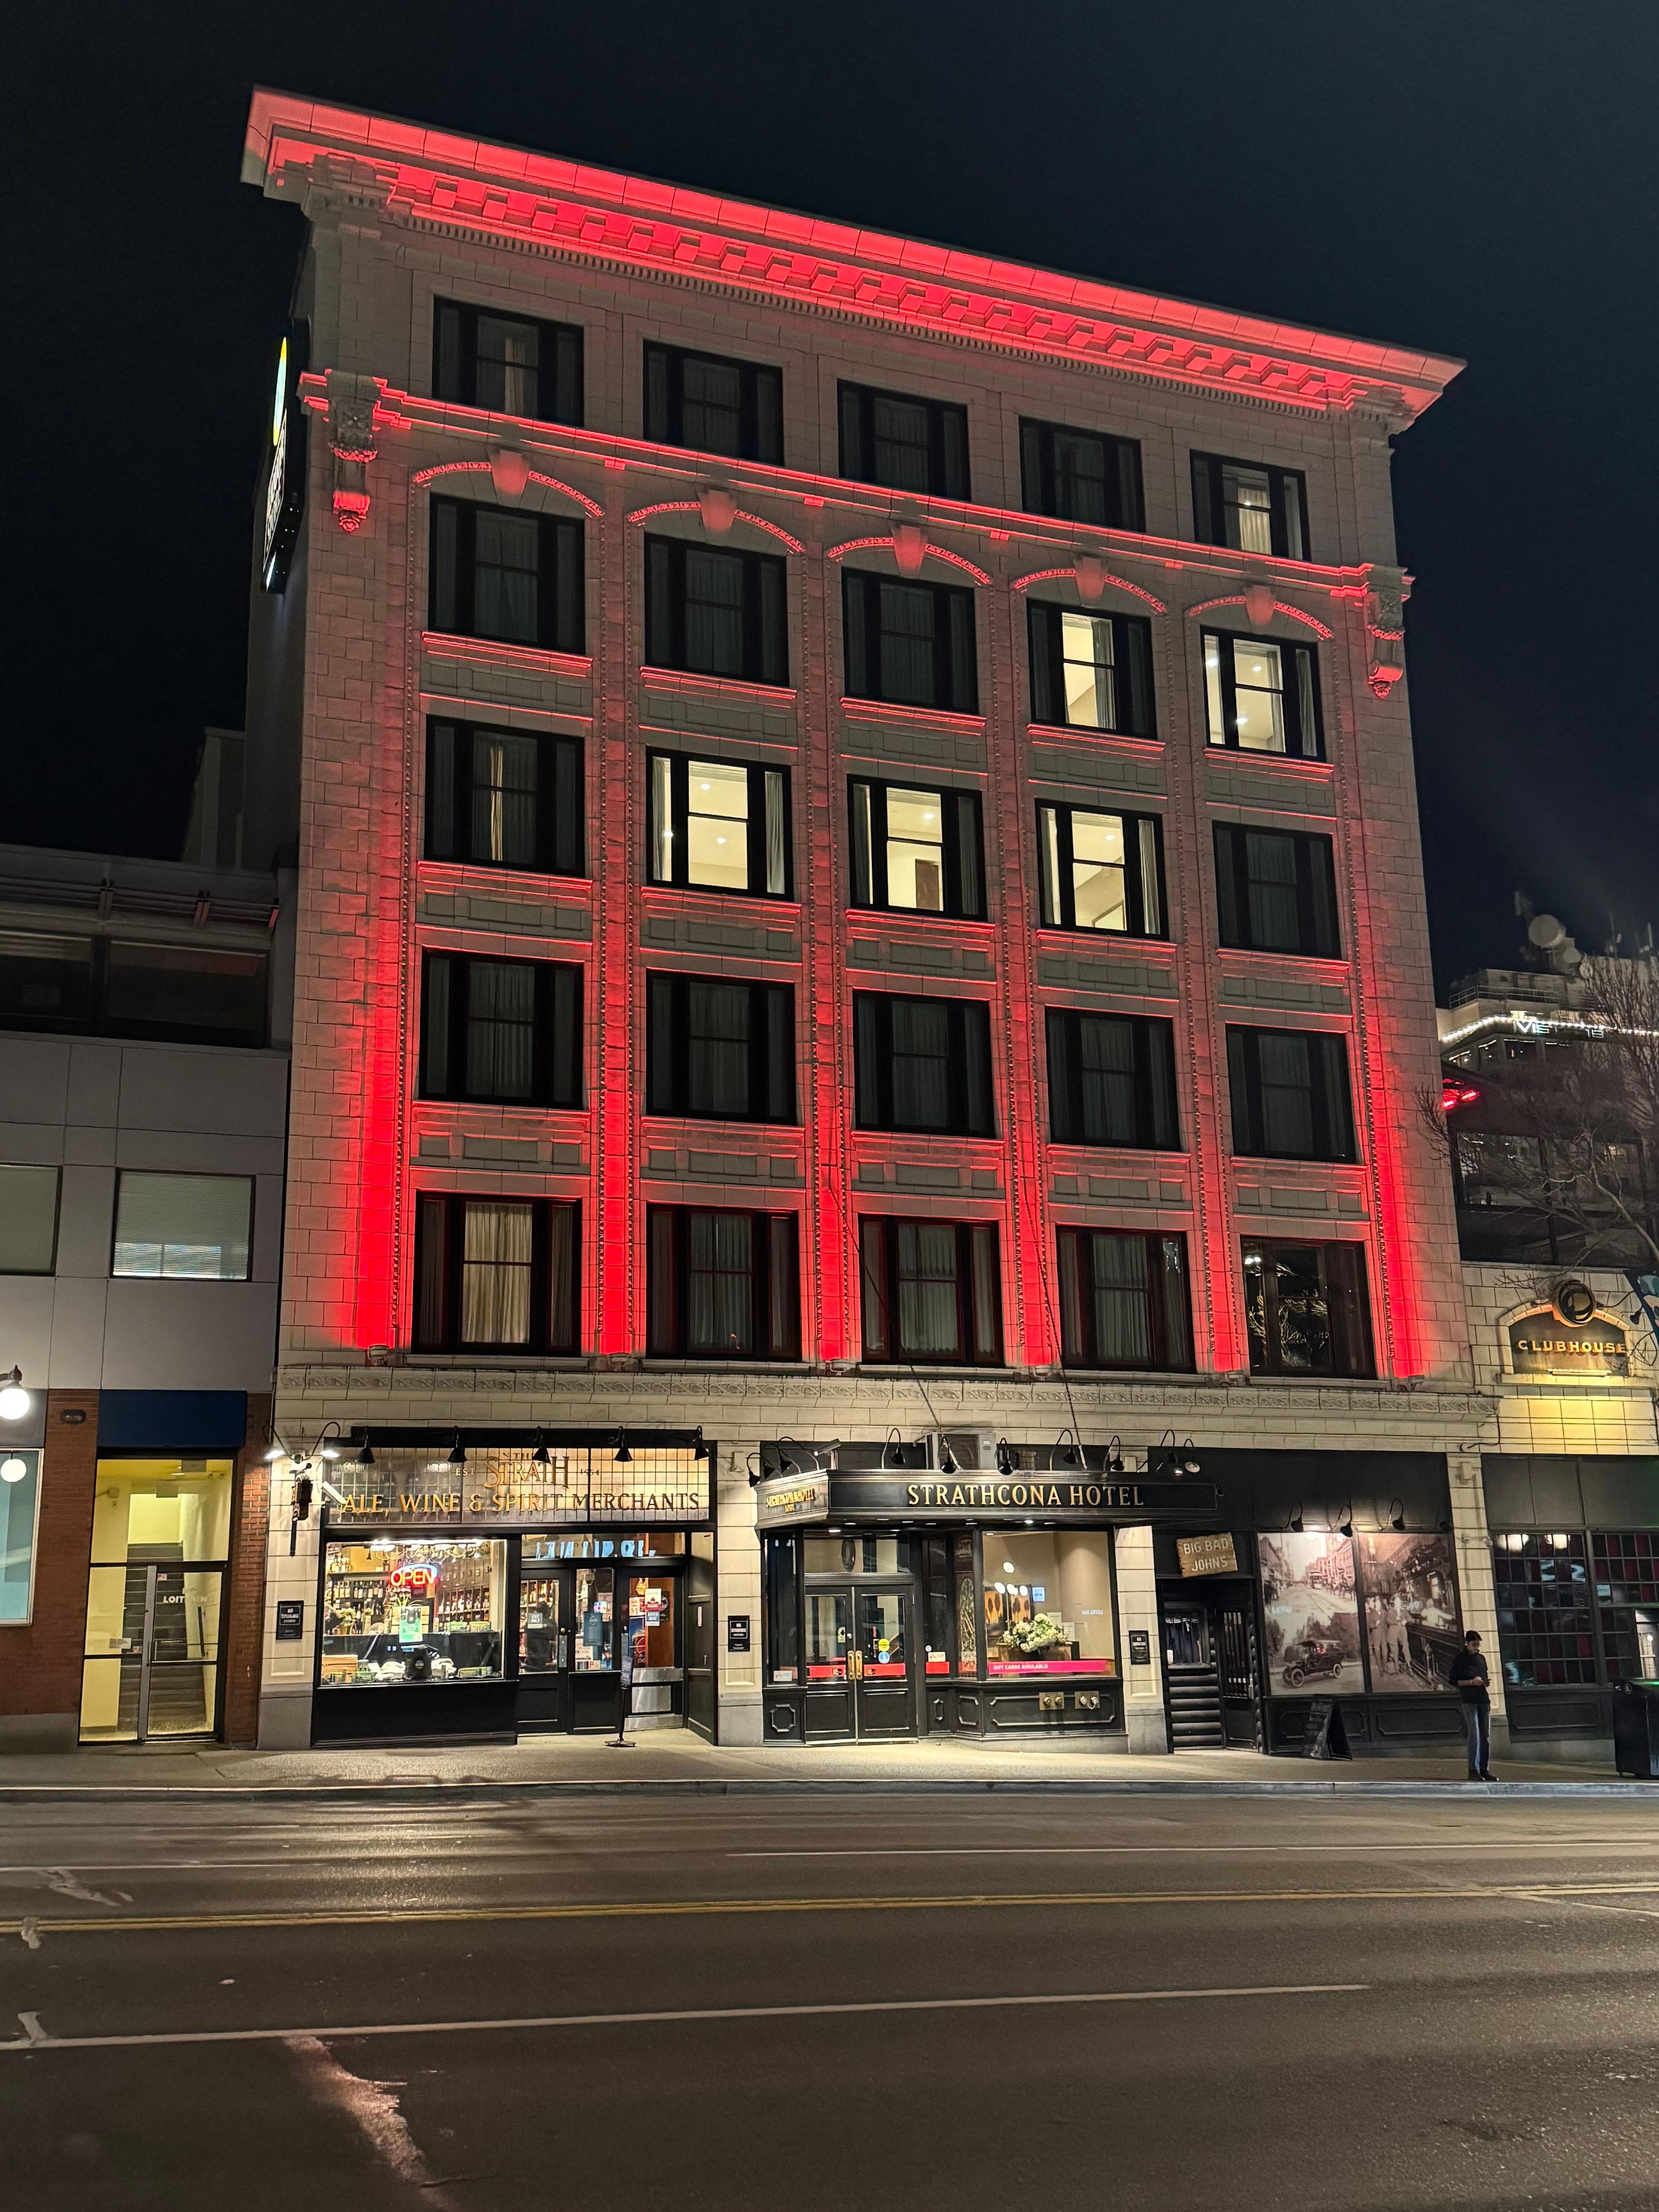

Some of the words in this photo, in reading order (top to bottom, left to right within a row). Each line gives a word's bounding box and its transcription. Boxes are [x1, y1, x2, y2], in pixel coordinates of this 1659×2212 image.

[1518, 1340, 1626, 1353] CLUBHOUSE
[455, 1468, 474, 1476] EST
[484, 1456, 569, 1489] STRATH
[908, 1485, 1061, 1506] STRATHCONA
[1070, 1486, 1144, 1505] HOTEL
[343, 1494, 389, 1516] ALE,
[400, 1493, 460, 1512] WINE
[469, 1494, 482, 1511] &
[492, 1494, 562, 1511] SPIRIT
[572, 1493, 699, 1511] MERCHANTS
[1183, 1542, 1201, 1554] BIG
[1205, 1538, 1228, 1551] BAD
[1192, 1556, 1228, 1571] JOHNS
[391, 1569, 434, 1586] OPEN
